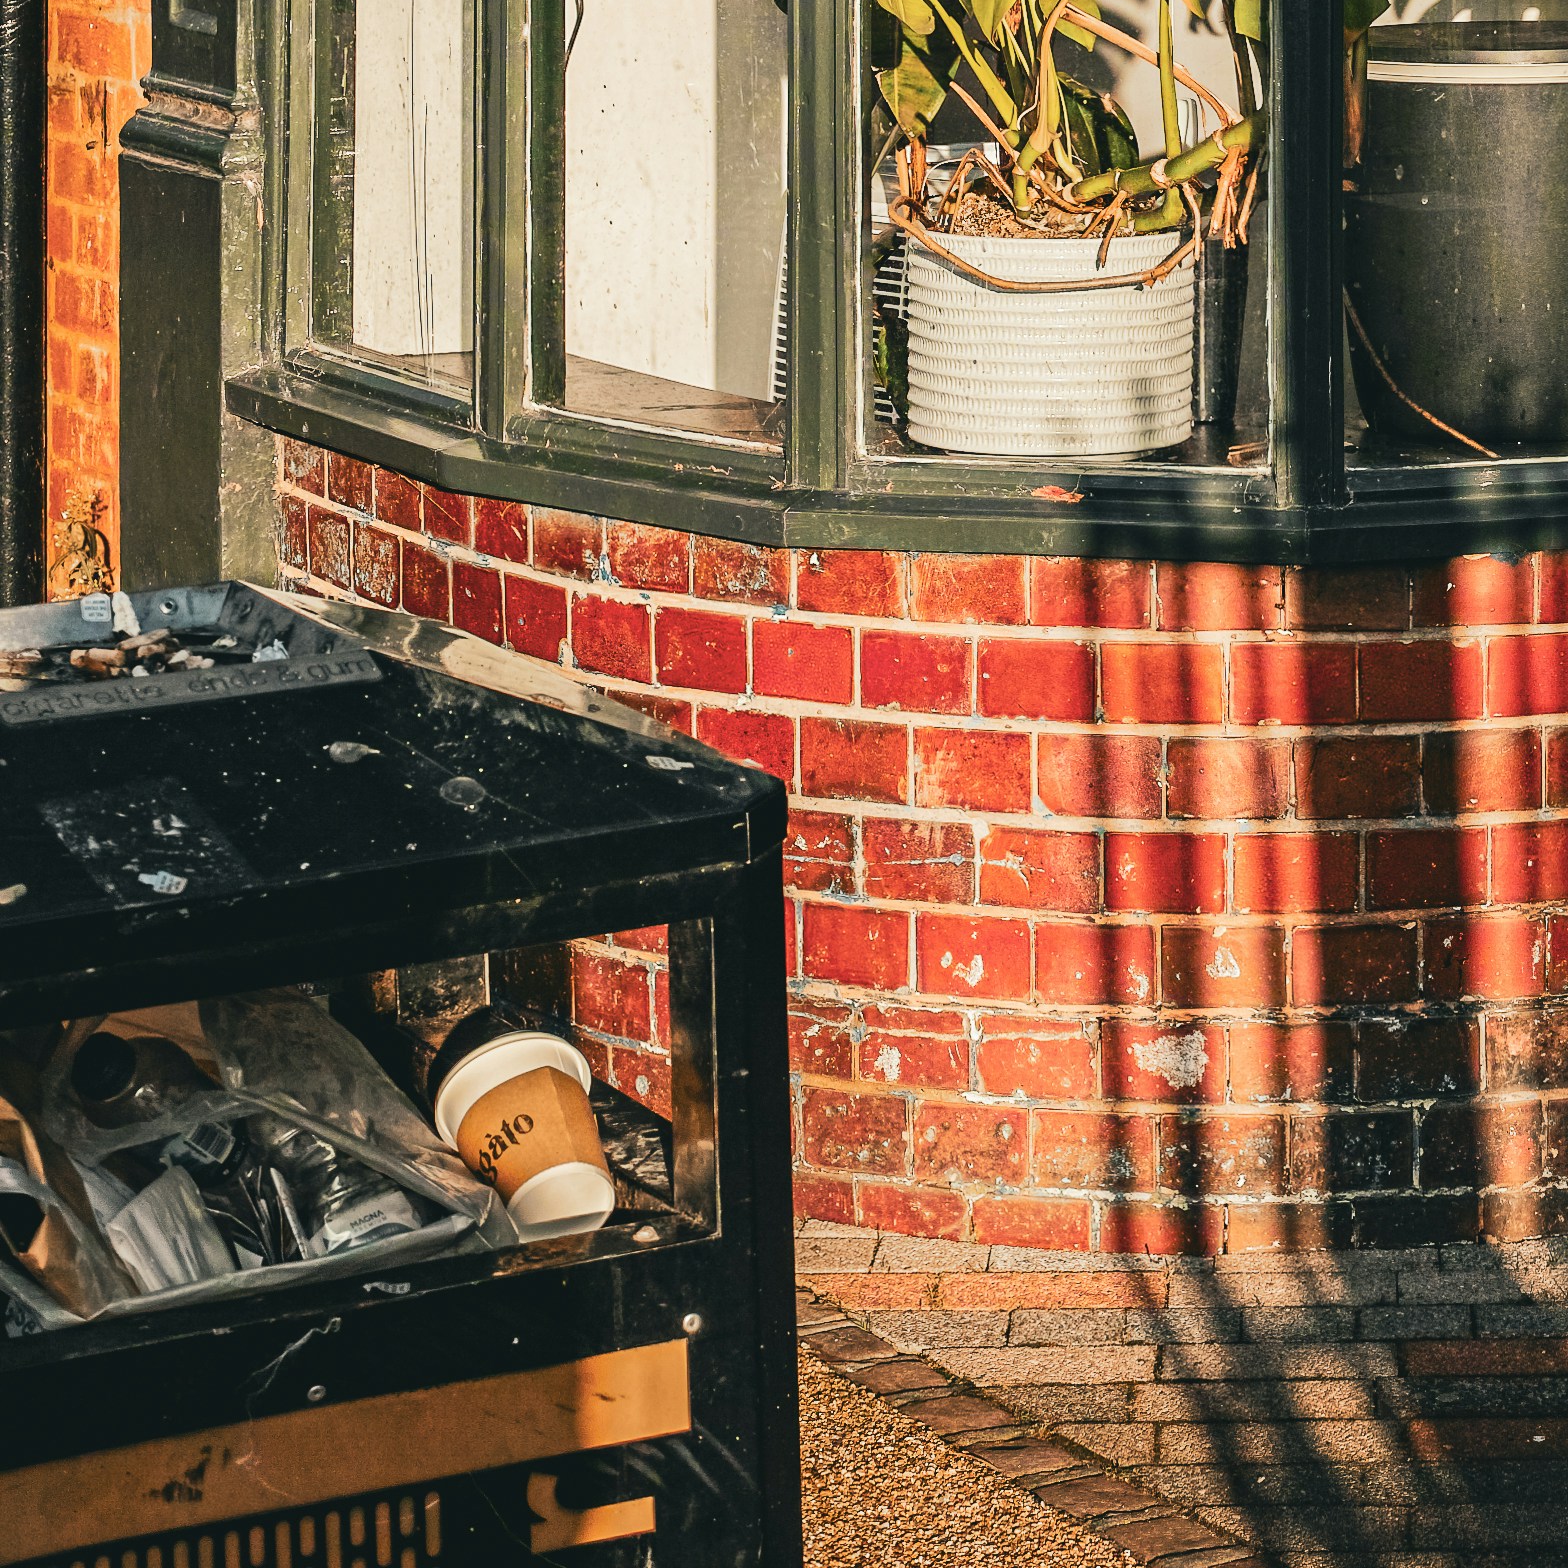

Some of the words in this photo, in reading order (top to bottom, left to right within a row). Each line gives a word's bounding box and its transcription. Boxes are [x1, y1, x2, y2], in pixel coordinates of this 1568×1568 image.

[2, 683, 164, 717] cigarette
[188, 667, 268, 693] ends
[278, 664, 303, 683] &
[307, 659, 374, 682] gum
[349, 1209, 385, 1229] MAGNA
